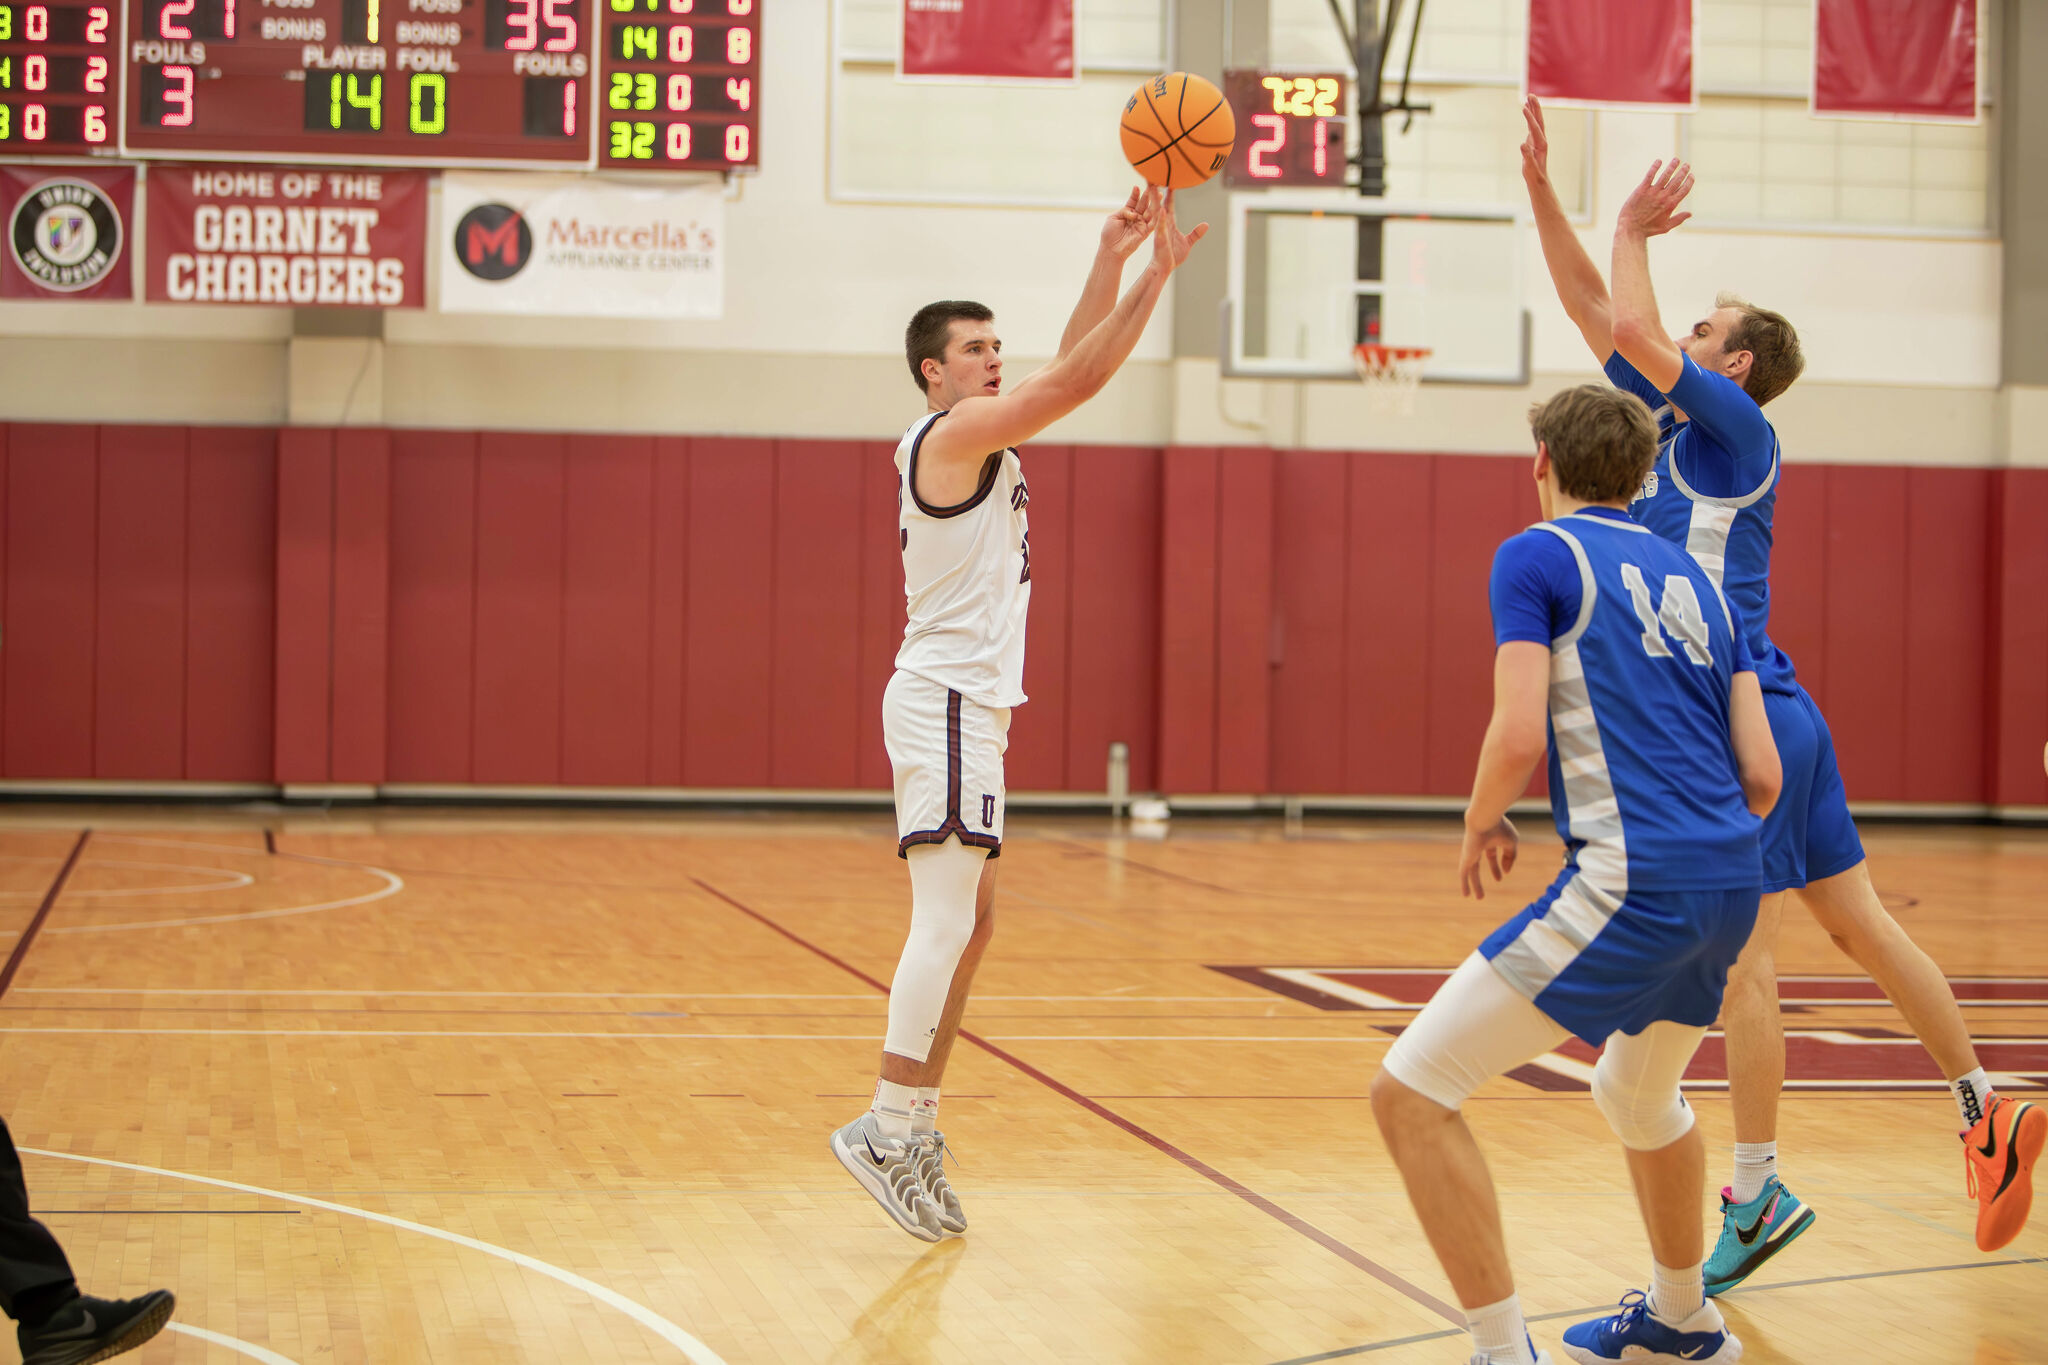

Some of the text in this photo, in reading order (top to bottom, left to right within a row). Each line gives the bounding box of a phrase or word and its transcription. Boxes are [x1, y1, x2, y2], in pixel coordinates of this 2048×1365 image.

[26, 6, 47, 41] 0
[86, 7, 108, 43] 2
[160, 0, 236, 39] 21
[261, 17, 326, 41] BONUS
[396, 20, 461, 46] BONUS
[504, 0, 577, 52] 35
[132, 40, 206, 64] FOULS
[302, 45, 460, 73] PLAYER FOUL
[623, 25, 751, 64] 14 0 8
[25, 55, 47, 90] 0
[85, 56, 107, 92] 2
[513, 52, 588, 77] FOULS
[161, 65, 194, 126] 3
[330, 73, 381, 130] 14
[410, 73, 446, 134] 0
[563, 80, 577, 136] 1
[609, 73, 750, 111] 23 0 4
[23, 103, 46, 140] 0
[84, 105, 106, 142] 6
[609, 121, 750, 161] 32 0 0
[1249, 114, 1327, 177] 21
[192, 171, 382, 200] HOME OF THE
[194, 205, 380, 255] GARNET
[546, 217, 716, 251] Marcella's
[167, 254, 404, 305] CHARGERS
[1621, 562, 1713, 669] 14
